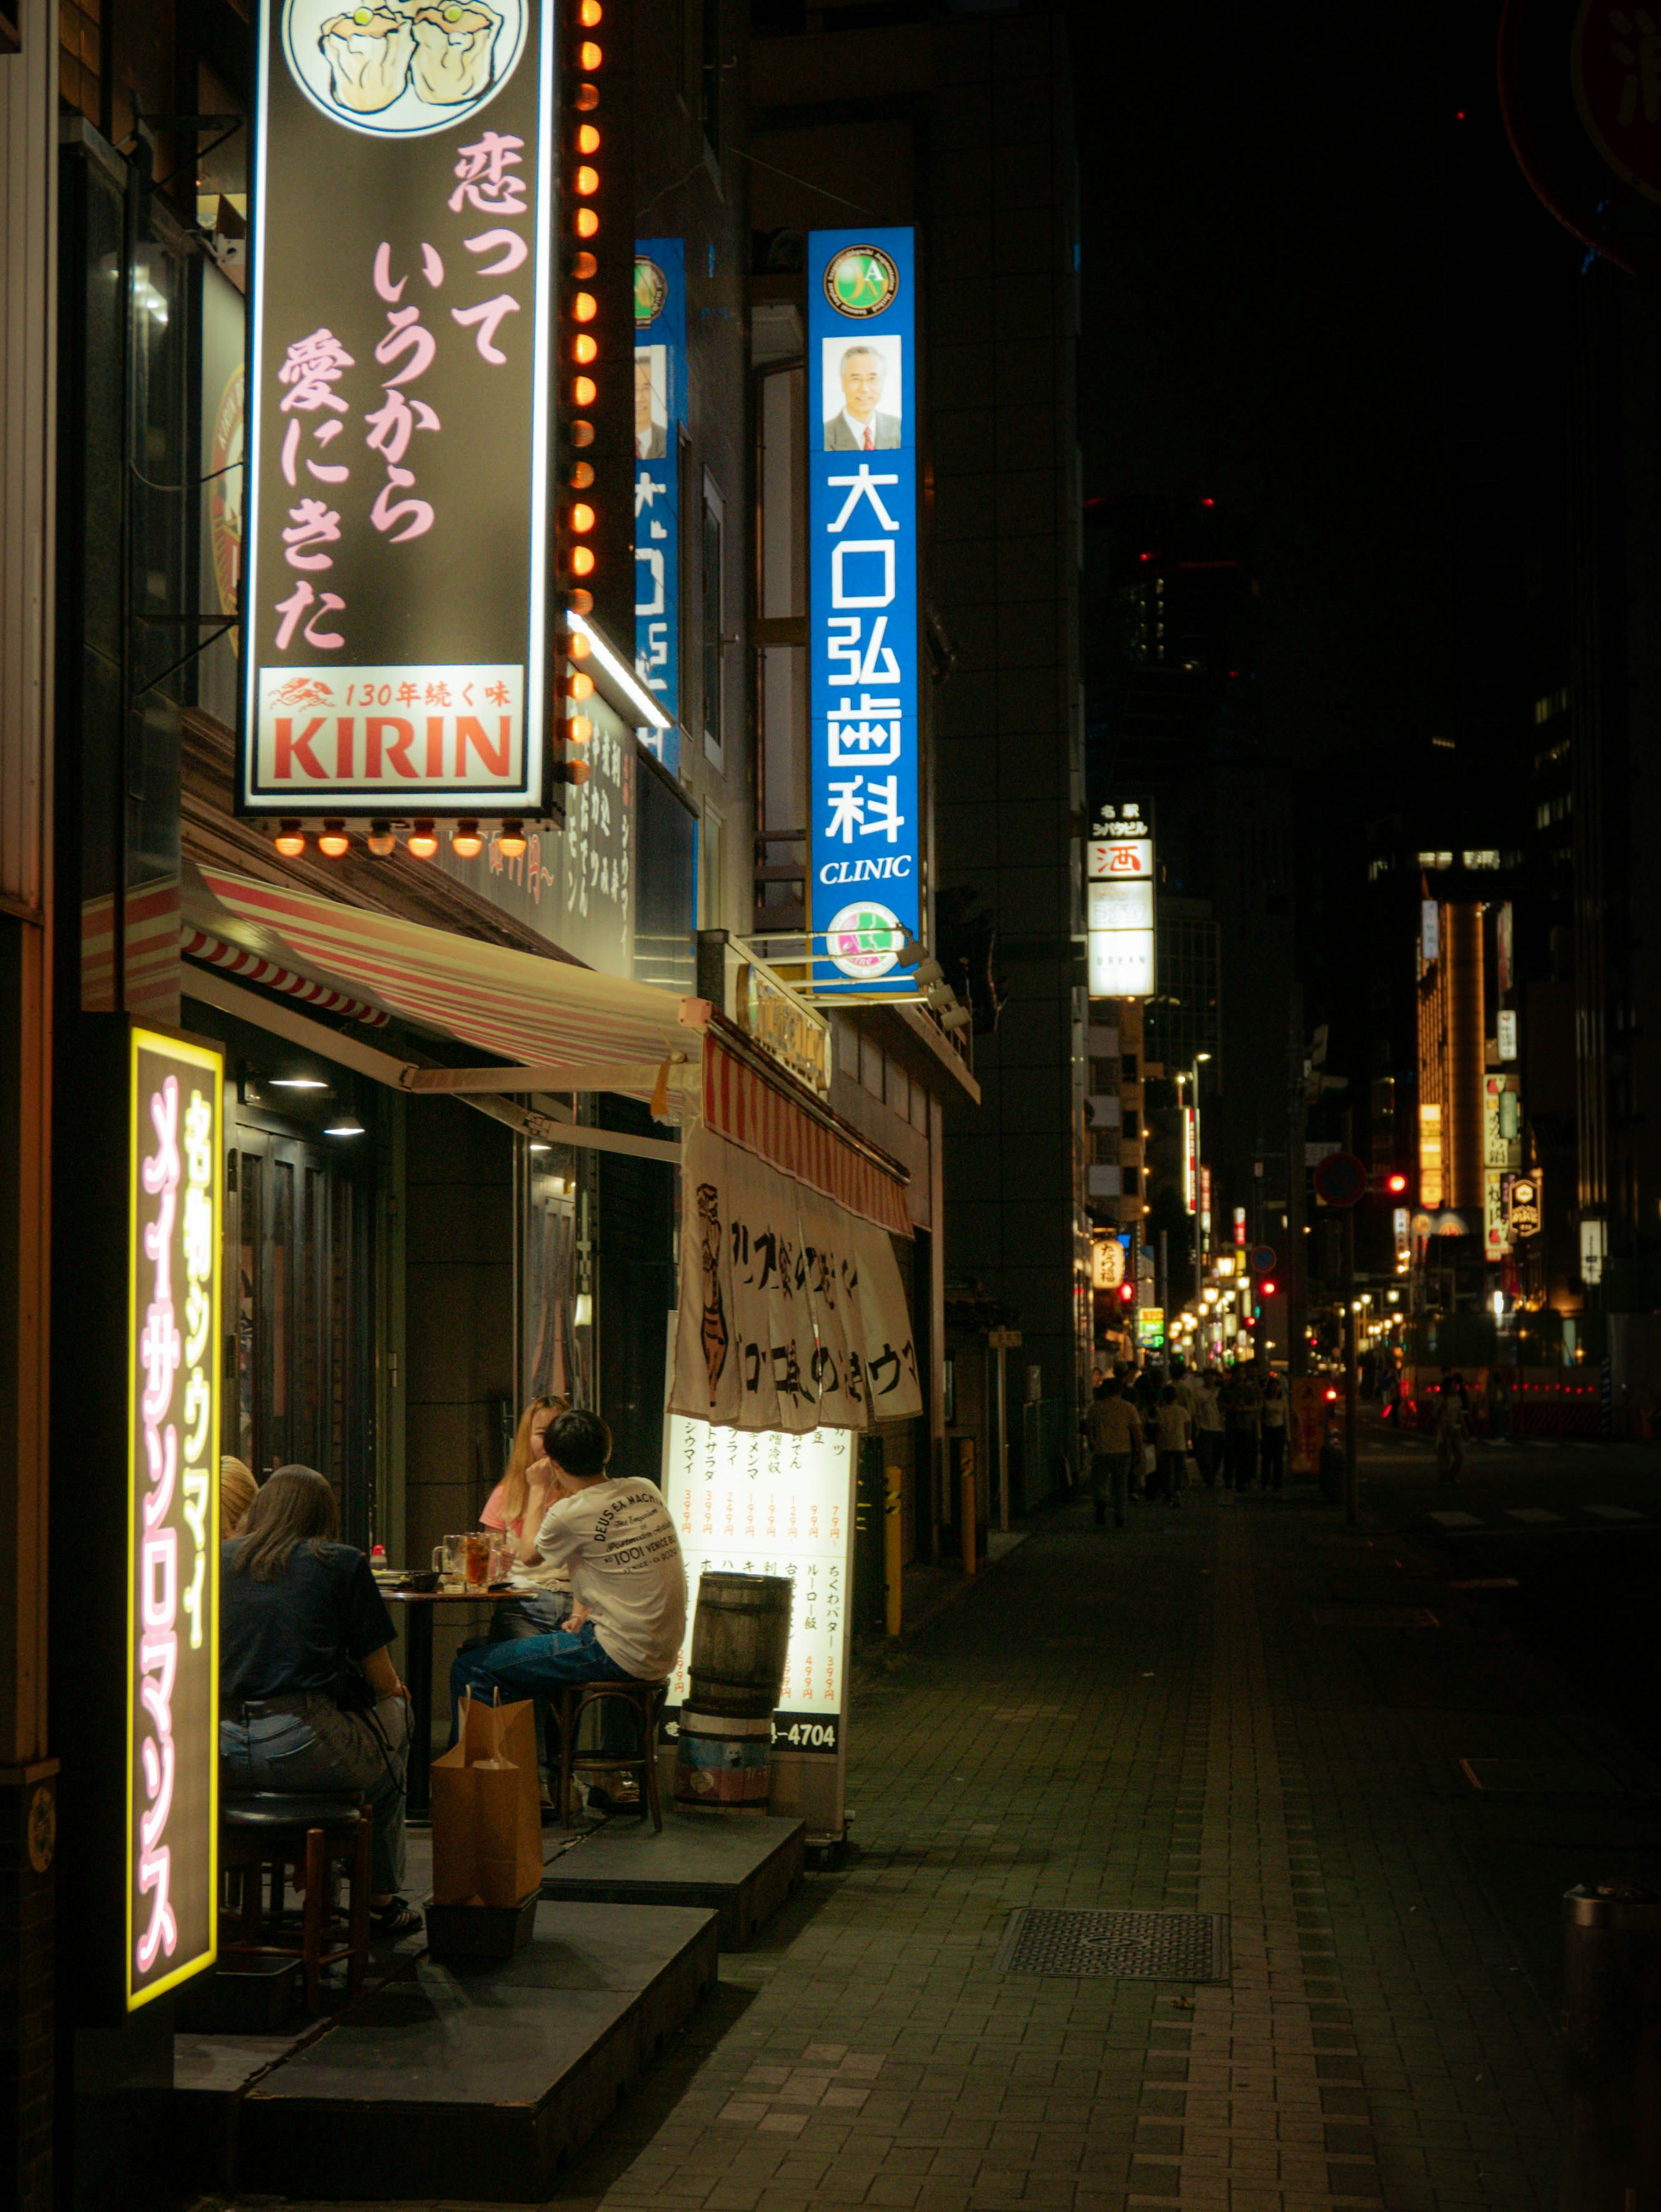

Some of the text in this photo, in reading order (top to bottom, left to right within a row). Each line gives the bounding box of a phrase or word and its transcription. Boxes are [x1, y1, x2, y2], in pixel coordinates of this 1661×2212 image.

[448, 131, 528, 365] 恋って
[364, 242, 445, 543] いうから
[275, 327, 355, 650] 愛にきた
[825, 464, 905, 843] 大口弘歯科
[344, 679, 512, 709] 130年続く味
[273, 716, 512, 780] KIRIN
[820, 855, 911, 886] CLINIC
[1096, 846, 1141, 873] 酒
[684, 1422, 697, 1474] シウマイ
[594, 1509, 614, 1542] DEUS
[611, 1500, 627, 1512] EX
[614, 1545, 645, 1565] 1001
[826, 1564, 840, 1648] ちくわバター
